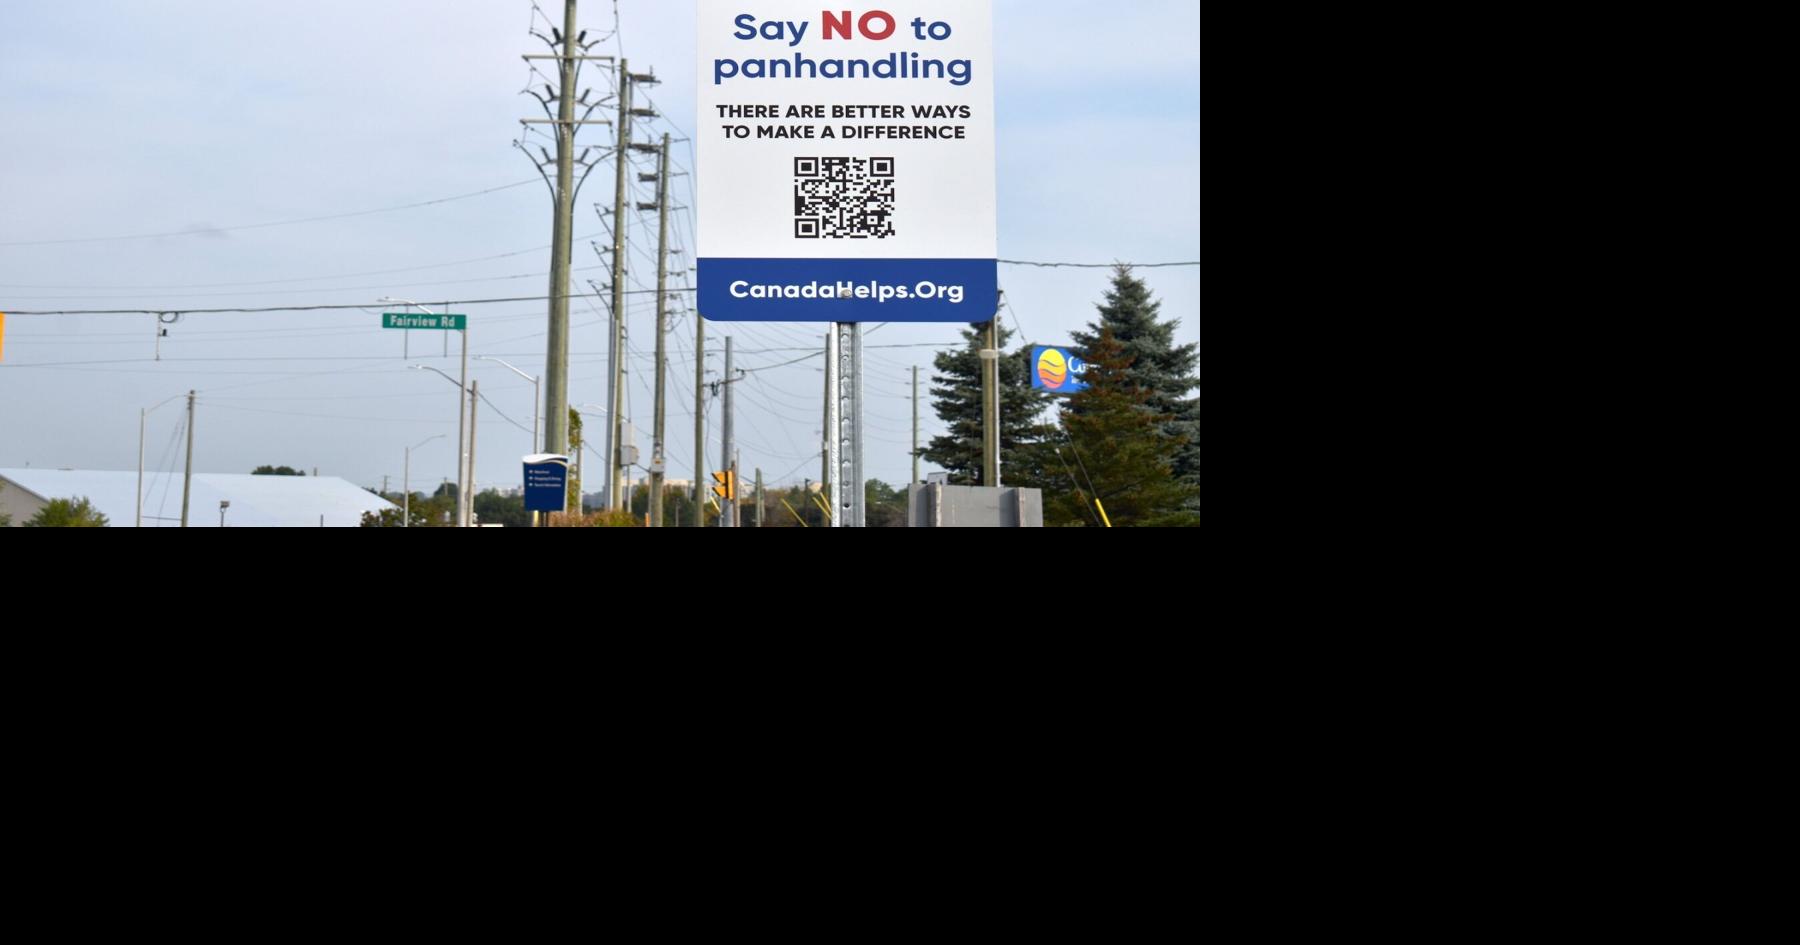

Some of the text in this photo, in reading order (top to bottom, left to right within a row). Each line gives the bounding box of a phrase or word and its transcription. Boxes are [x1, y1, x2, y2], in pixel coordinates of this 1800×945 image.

[733, 10, 952, 47] Say NO to
[714, 52, 972, 86] panhandling
[716, 105, 971, 119] THERE ARE BETTER WAYS
[722, 125, 966, 140] TO MAKE A DIFFERENCE
[729, 280, 964, 303] CanadaHelps.Org
[390, 315, 456, 327] Fairview Rd
